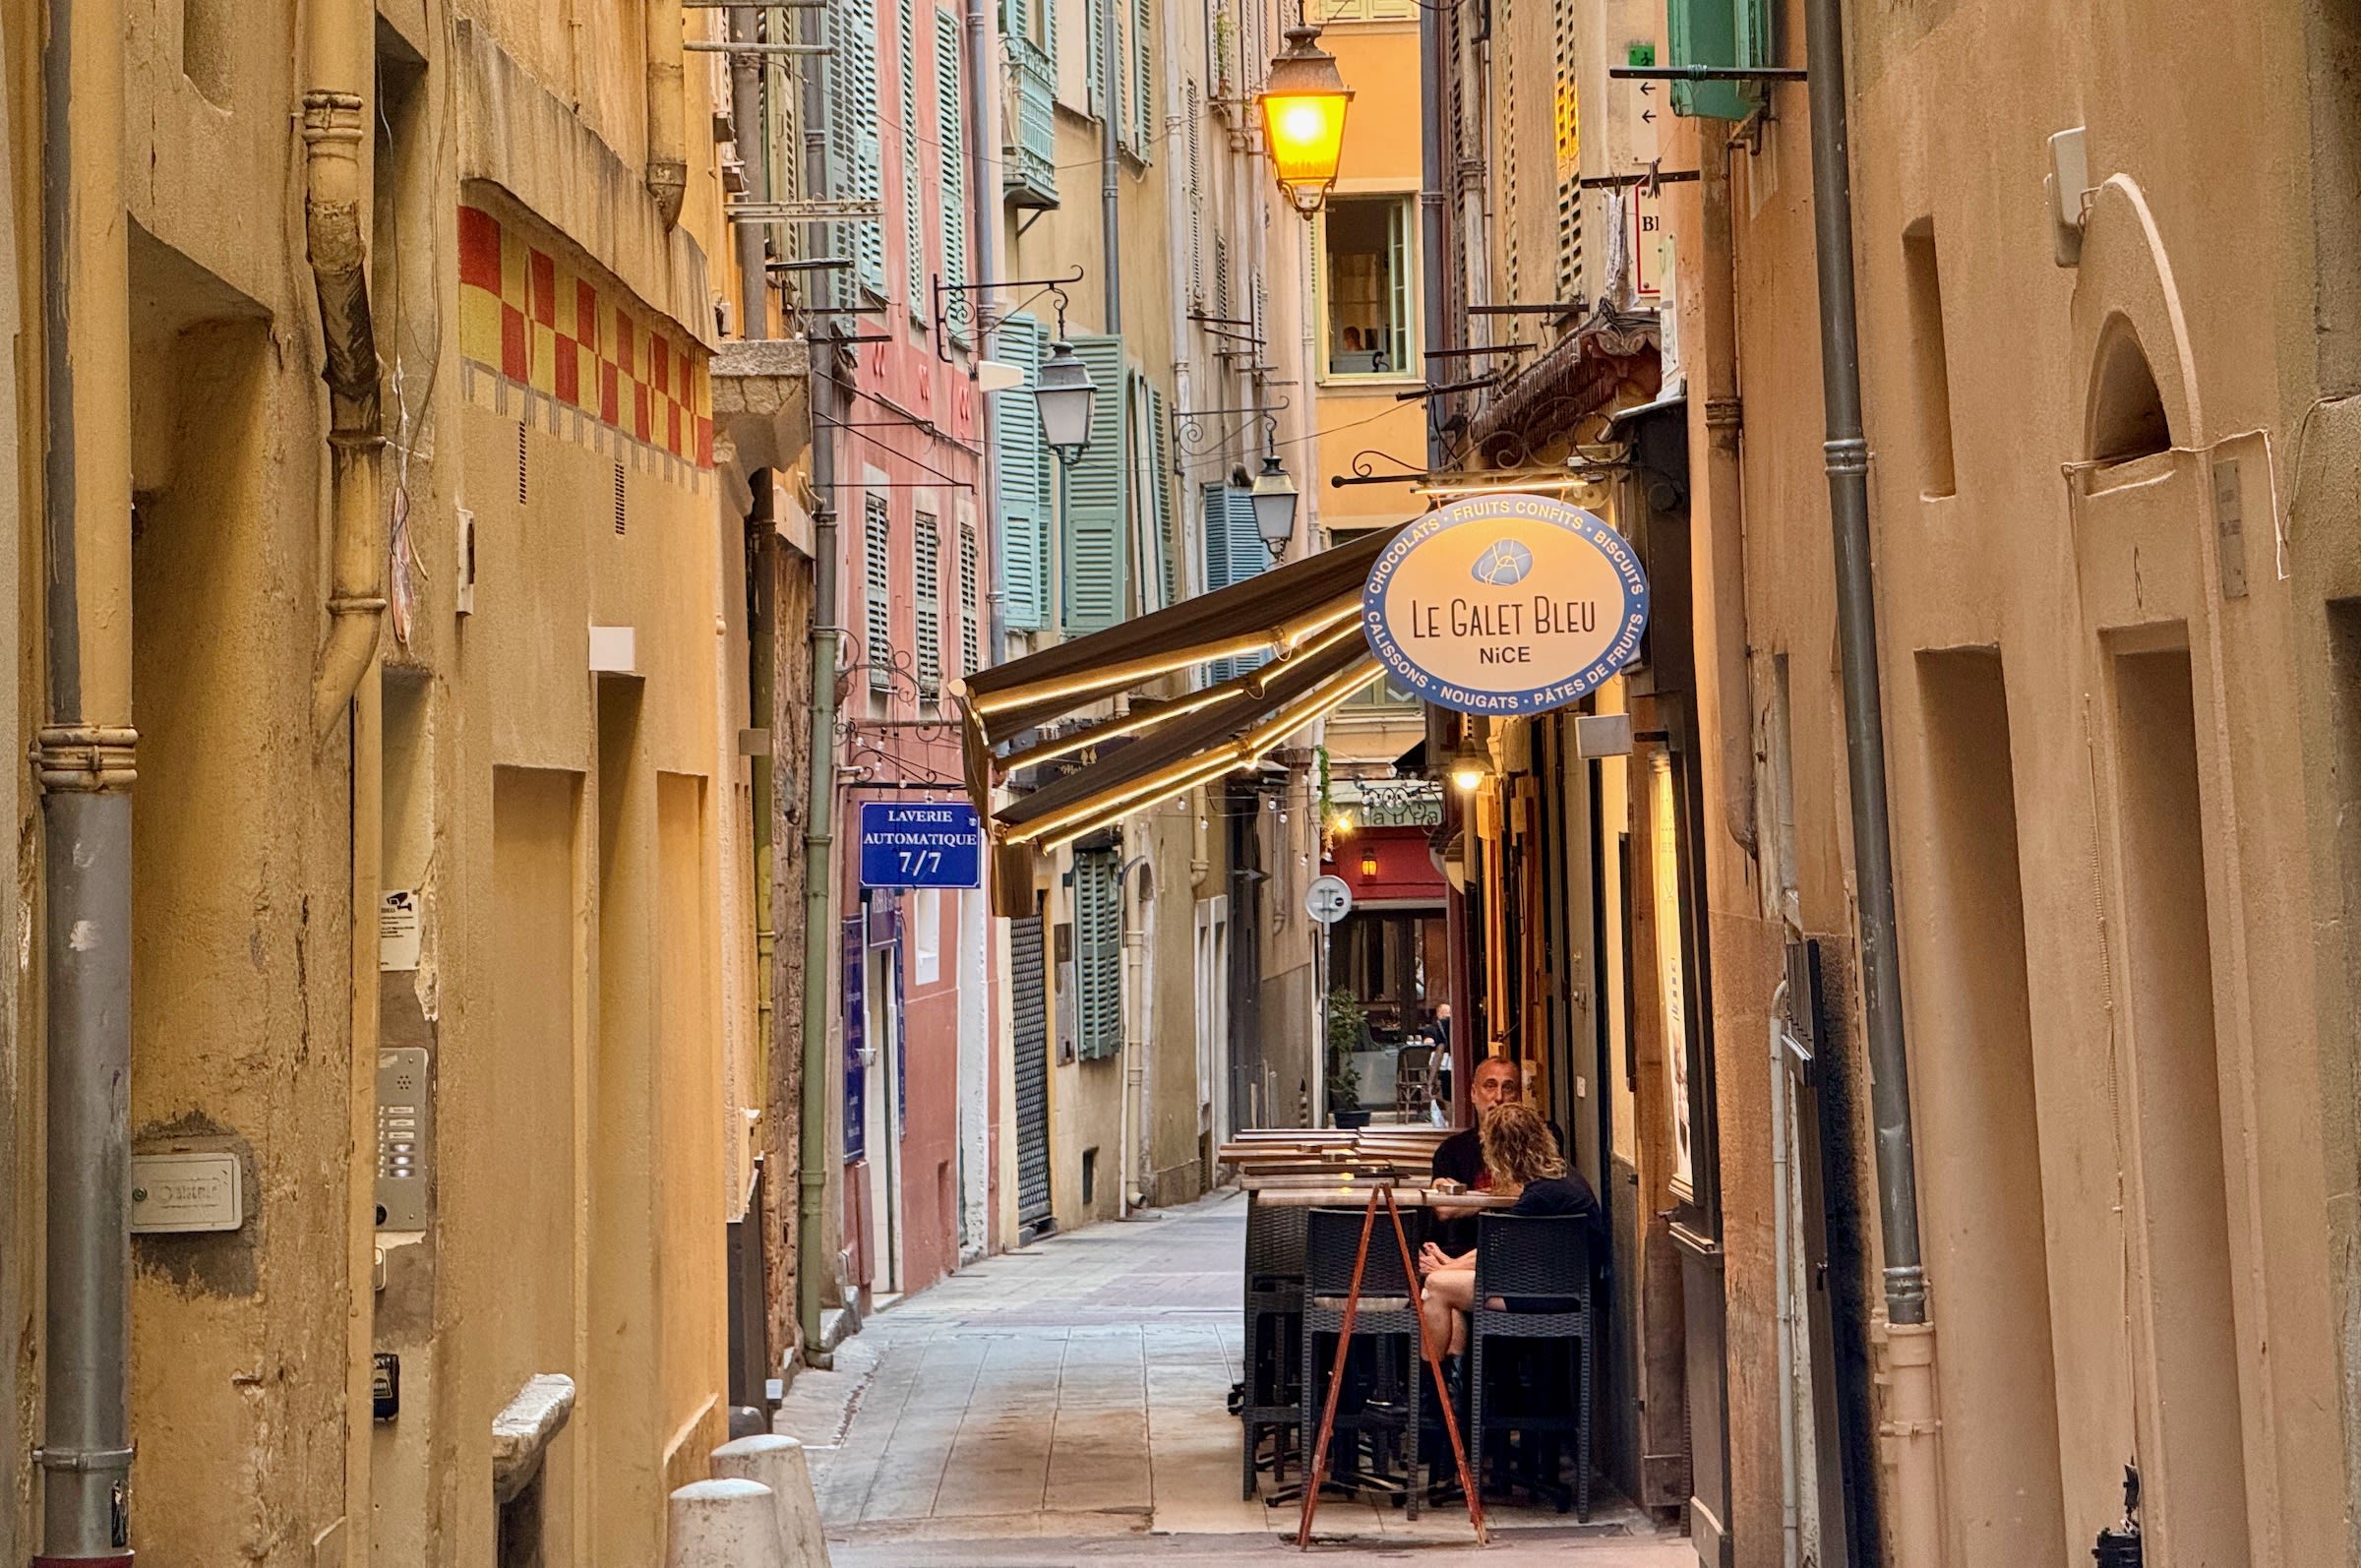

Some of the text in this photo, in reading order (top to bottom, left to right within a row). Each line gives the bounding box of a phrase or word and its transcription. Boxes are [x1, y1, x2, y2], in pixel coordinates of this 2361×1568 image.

[1452, 501, 1584, 531] FRUITS CONFITS
[1368, 517, 1441, 595] CHOCOLATS
[1593, 529, 1644, 595] BISCUITS
[1412, 595, 1596, 638] LE GALET BLEU
[1367, 610, 1429, 689] CALISSONS
[1534, 613, 1644, 706] PÂTES DE FRUITS
[1439, 686, 1519, 709] NOUGATS
[887, 810, 953, 822] LAVERIE
[863, 832, 977, 848] AUTOMATIQUE
[898, 849, 942, 877] 7/7
